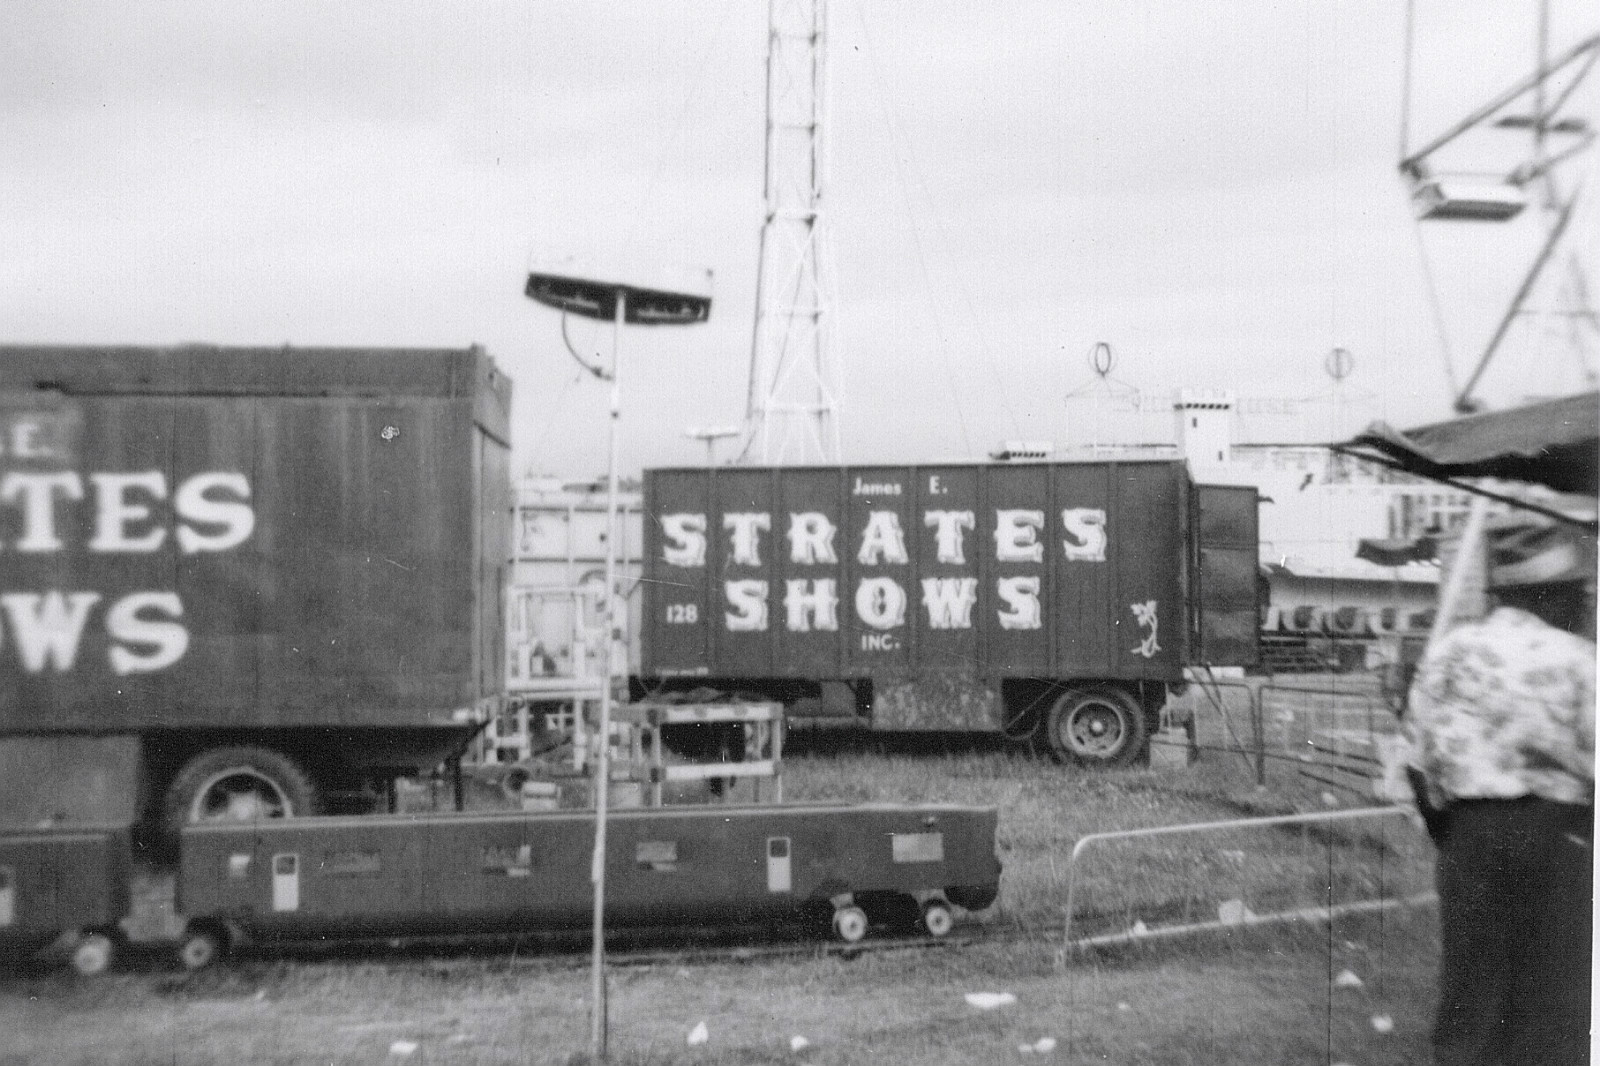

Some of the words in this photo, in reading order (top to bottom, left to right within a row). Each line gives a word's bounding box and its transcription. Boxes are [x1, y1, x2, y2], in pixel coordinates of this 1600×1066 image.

[0, 470, 255, 554] TES
[853, 477, 902, 496] James
[929, 475, 948, 495] E.
[660, 507, 1108, 568] STRATES
[666, 603, 699, 624] 128
[724, 576, 1043, 632] SHOWS
[0, 590, 189, 675] WS
[861, 633, 901, 651] INC.
